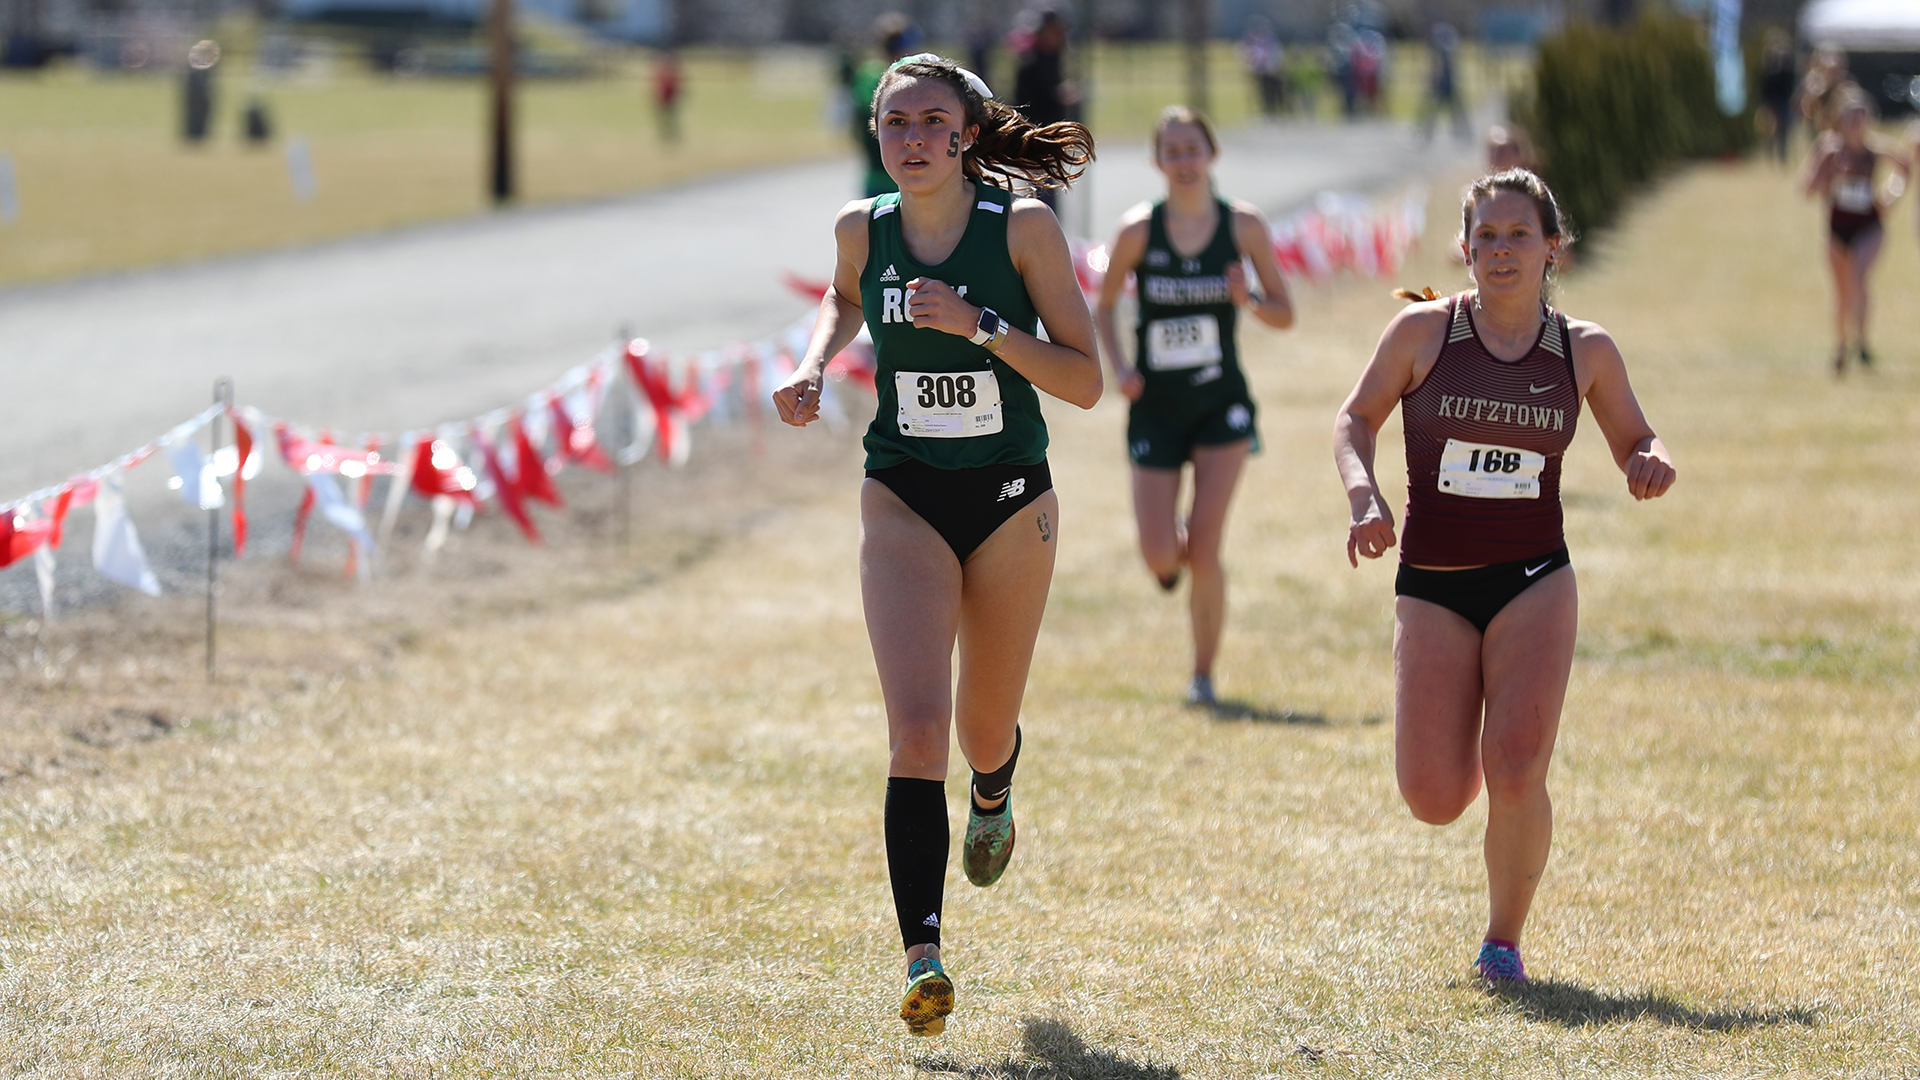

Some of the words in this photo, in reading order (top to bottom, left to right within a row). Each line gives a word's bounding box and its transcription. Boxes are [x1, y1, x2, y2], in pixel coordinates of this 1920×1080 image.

[947, 131, 960, 158] S
[916, 375, 977, 409] 308
[1438, 395, 1565, 432] KUTZTOWN
